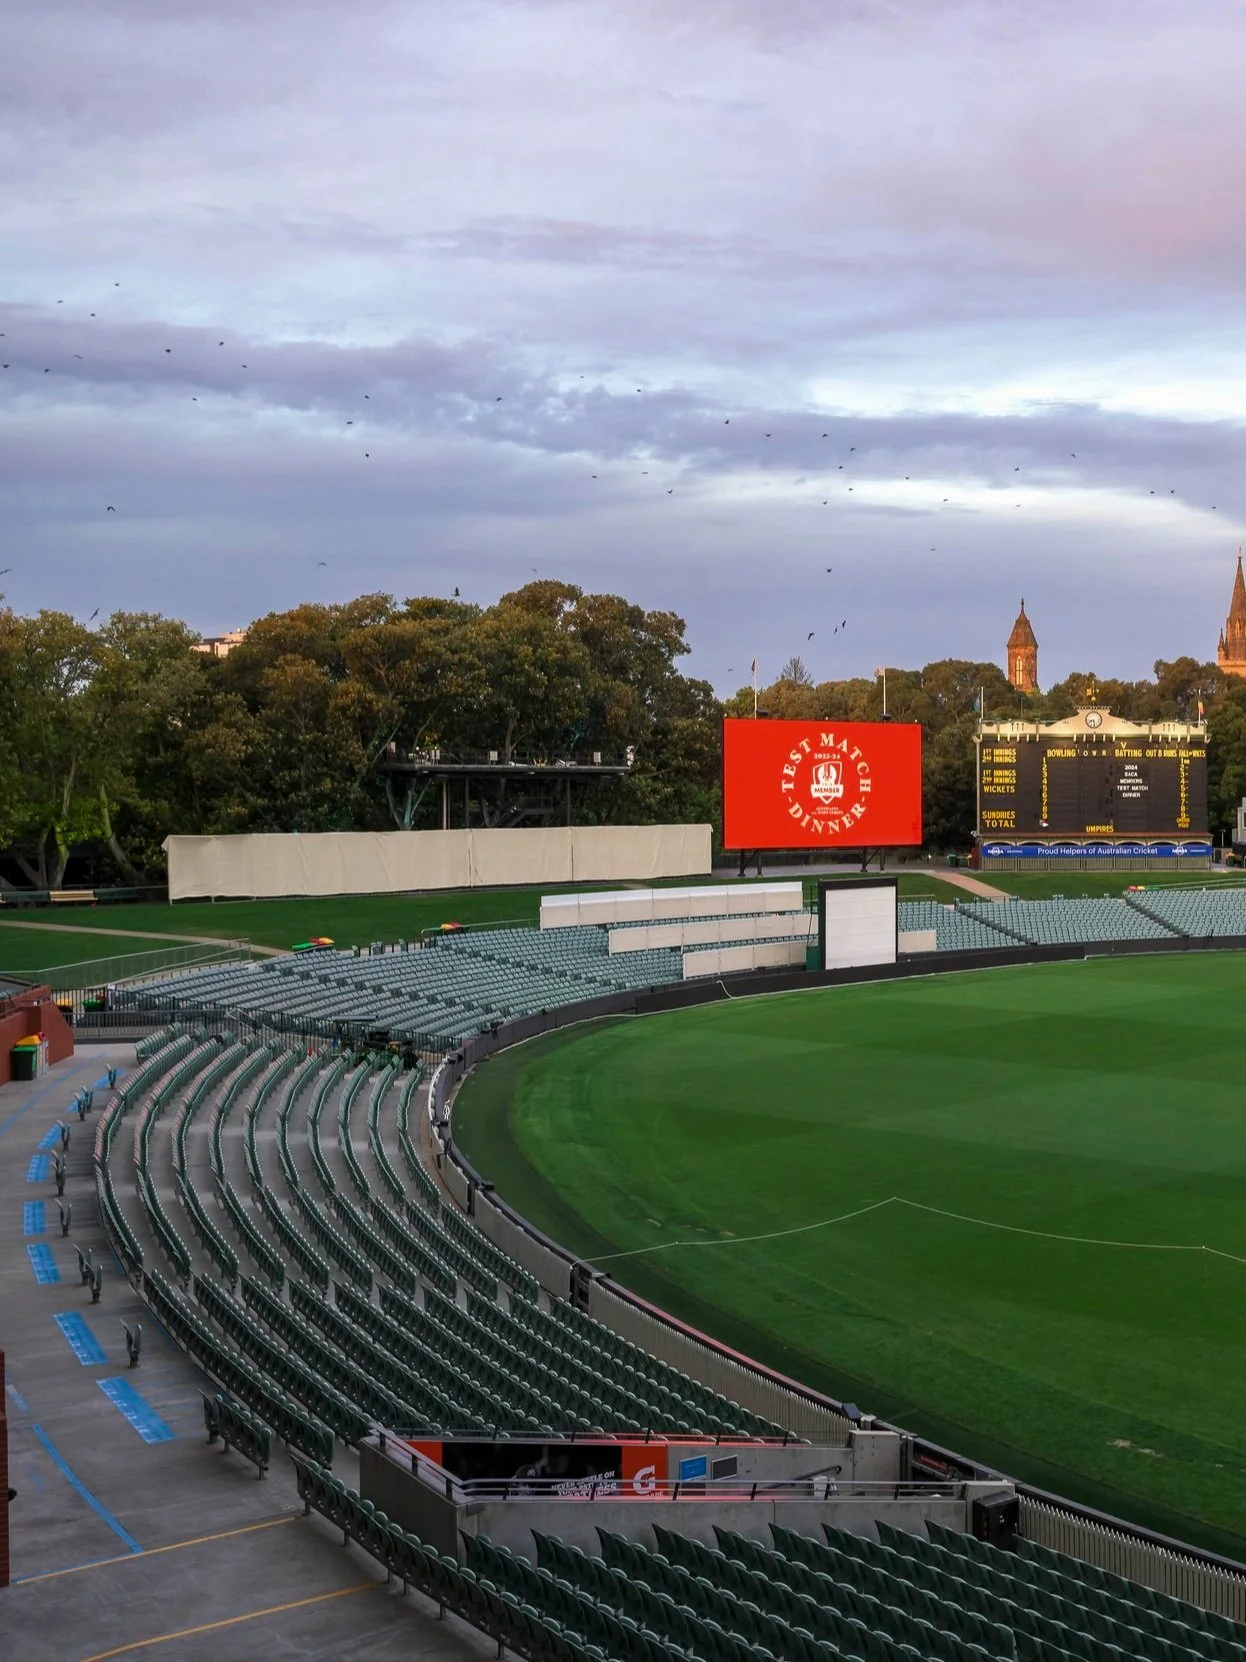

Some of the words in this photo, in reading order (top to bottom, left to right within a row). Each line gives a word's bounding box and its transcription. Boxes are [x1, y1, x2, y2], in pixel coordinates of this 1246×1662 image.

[994, 748, 1017, 756] INNINGS
[1047, 749, 1076, 757] BOWLING
[1115, 749, 1142, 757] BATTING
[1146, 749, 1157, 757] OUT
[782, 738, 811, 793] TEST
[820, 733, 871, 792] MATCH
[983, 785, 1016, 793] WICKETS
[788, 802, 866, 835] DINNER
[982, 811, 1016, 819] SUNDRIES
[985, 820, 1016, 828] TOTAL
[1085, 825, 1114, 833] UMPIRES
[1037, 847, 1059, 855] Proud
[1060, 847, 1087, 856] Helpers
[1088, 847, 1095, 855] of
[1097, 847, 1132, 855] Australian
[1133, 847, 1158, 855] Cricket
[603, 1470, 616, 1480] ON
[632, 1465, 656, 1495] G
